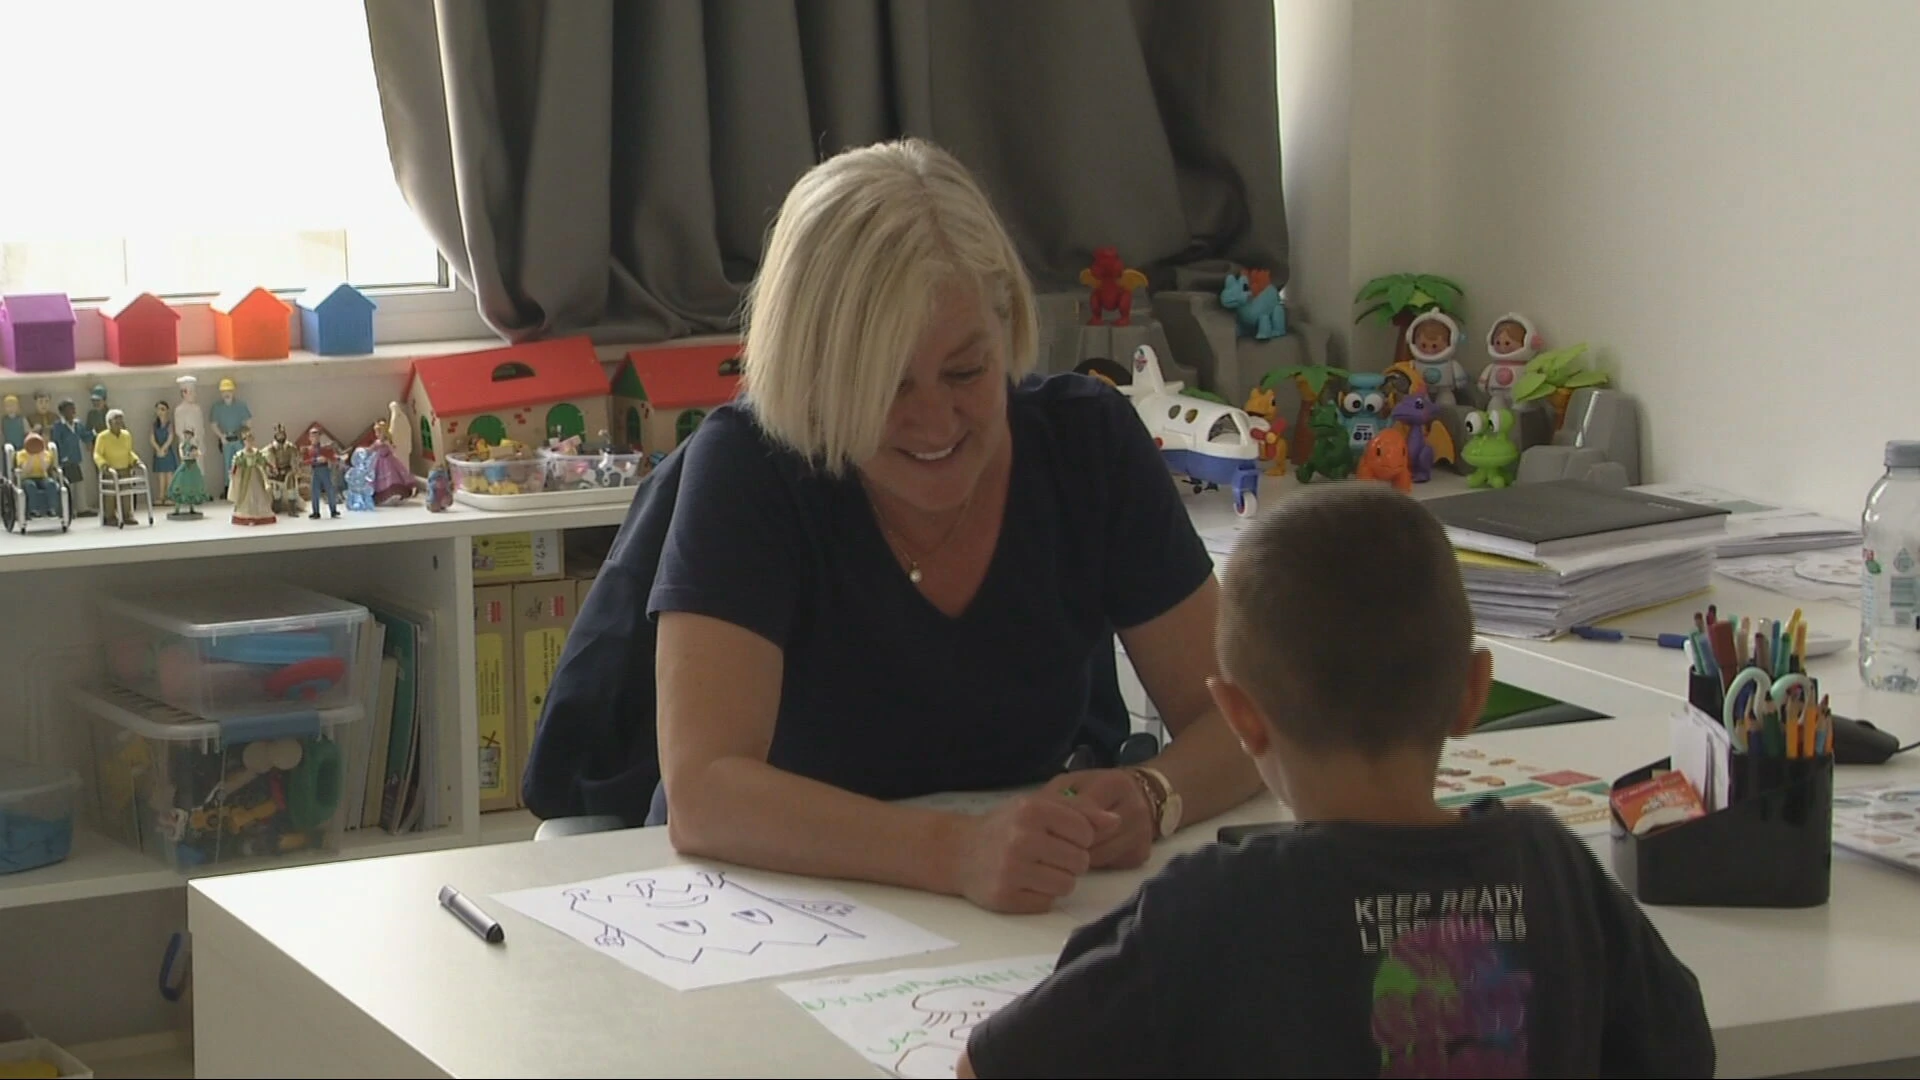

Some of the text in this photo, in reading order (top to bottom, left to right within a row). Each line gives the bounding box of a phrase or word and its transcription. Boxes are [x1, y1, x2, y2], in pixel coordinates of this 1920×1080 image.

[1354, 885, 1524, 925] KEEP READY
[1440, 912, 1527, 943] RULES
